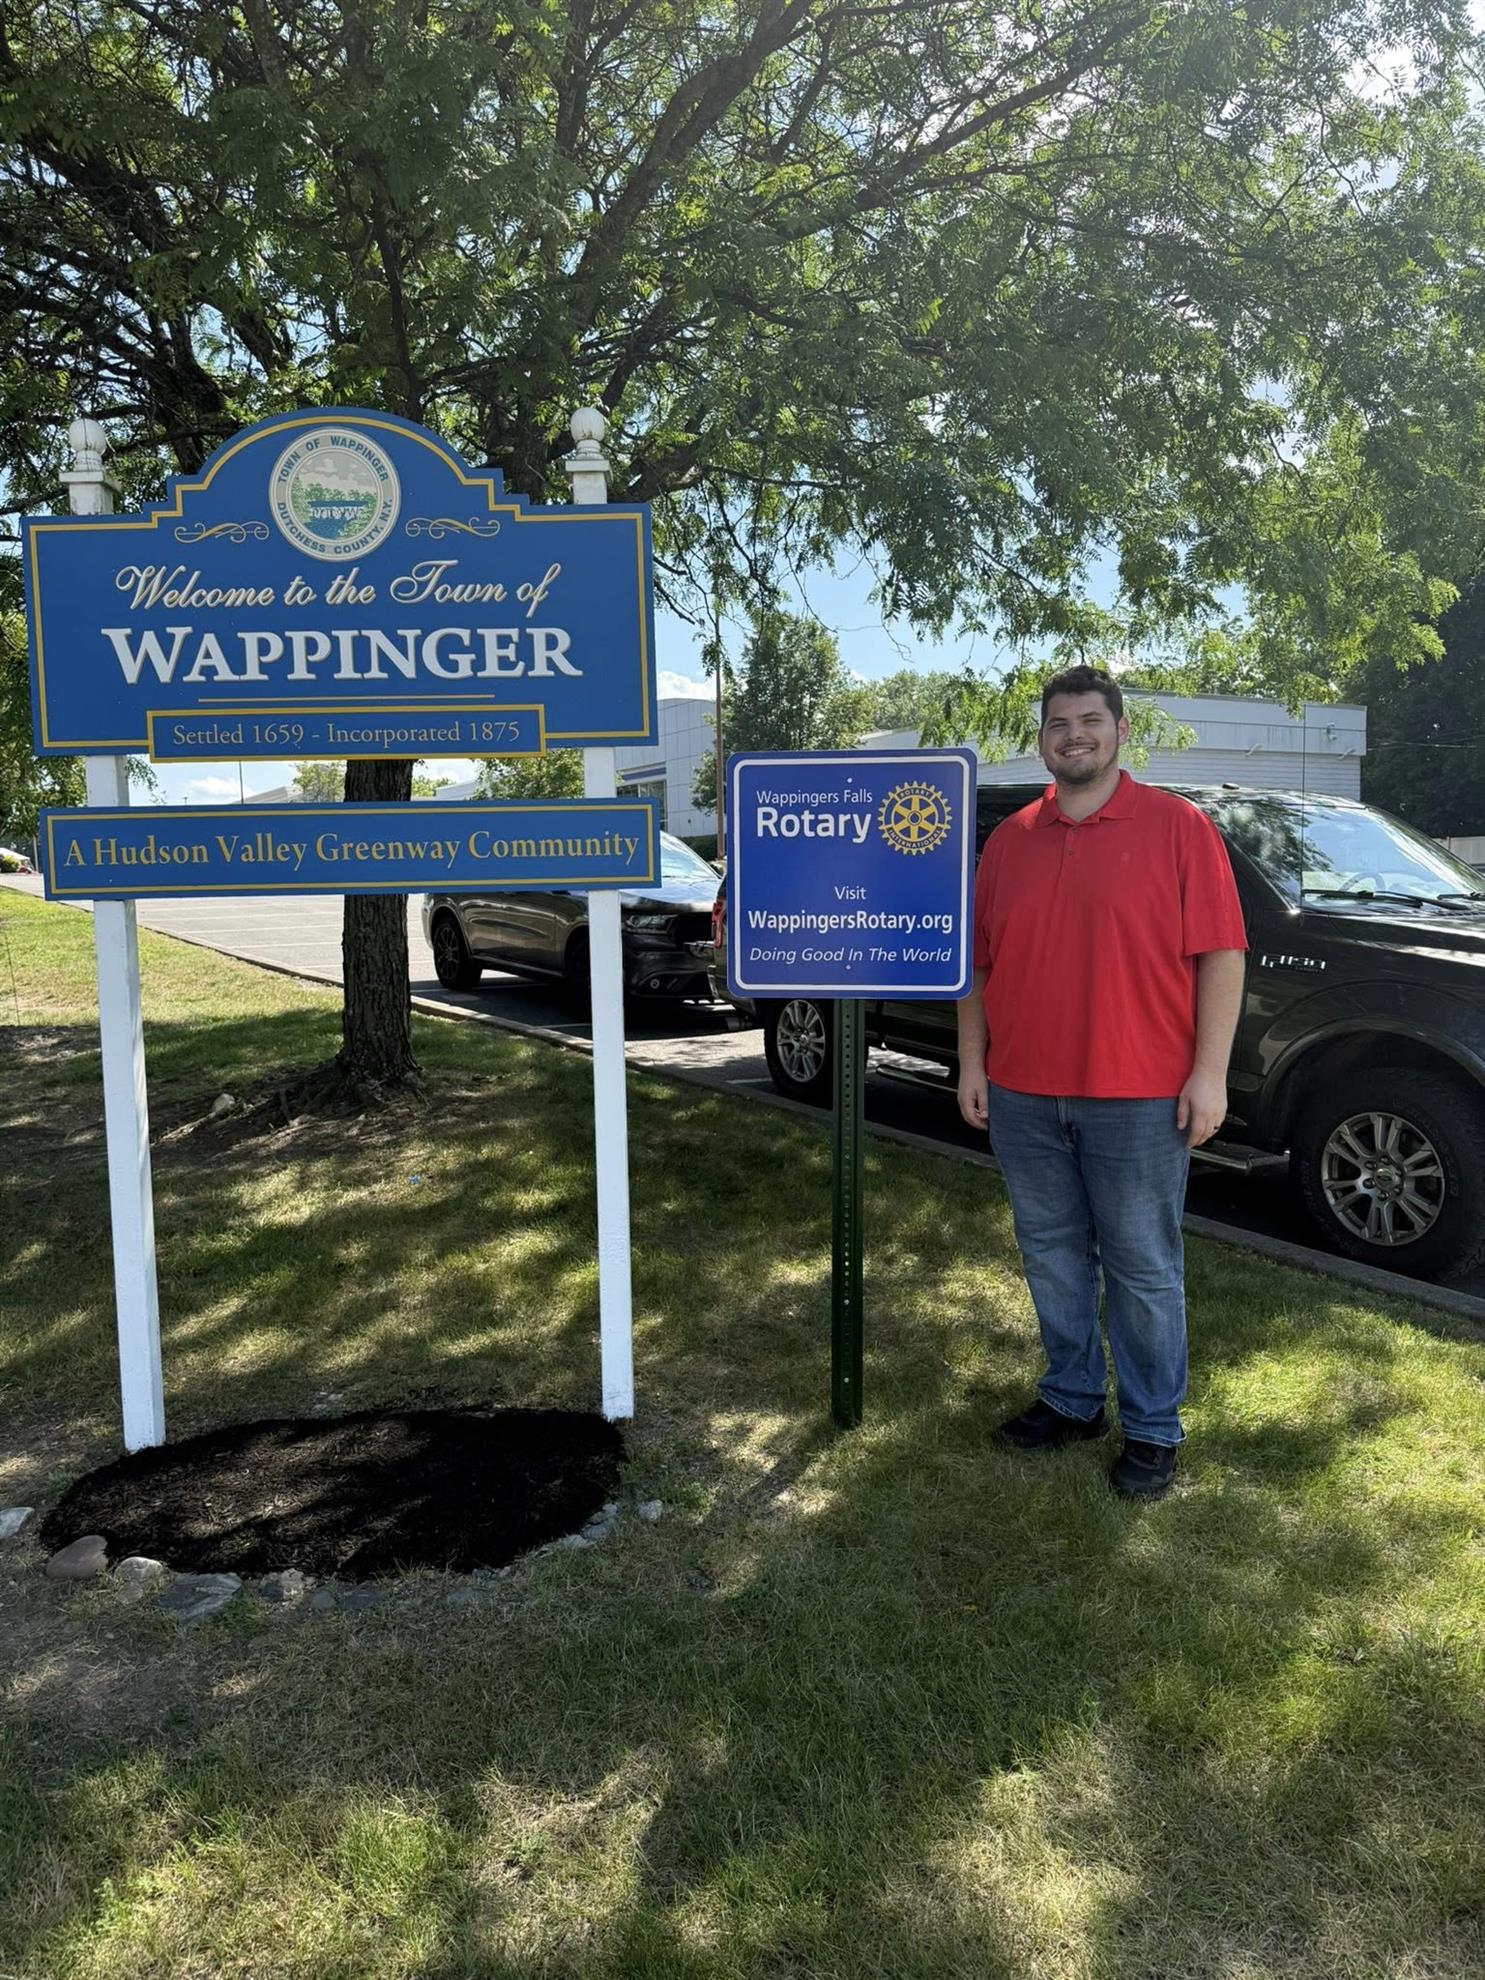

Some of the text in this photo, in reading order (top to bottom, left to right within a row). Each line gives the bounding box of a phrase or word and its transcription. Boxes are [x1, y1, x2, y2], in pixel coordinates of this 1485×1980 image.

[278, 435, 389, 484] TOWN OF WAPPINGER
[277, 502, 326, 553] DUTCHESS
[115, 559, 562, 619] Welcome to the Town of
[101, 626, 584, 685] WAPPINGER
[173, 723, 244, 745] Settled
[253, 723, 304, 747] 1659
[327, 721, 461, 749] Incorporated
[471, 721, 519, 742] 1875
[756, 789, 873, 807] Wappingers Falls
[757, 807, 872, 843] Rotary
[889, 830, 941, 848] INTERNATIONAL
[64, 830, 640, 872] A Hudson Valley Greenway Community
[834, 886, 866, 900] Visit
[748, 909, 953, 933] WappingersRotary.org
[750, 947, 951, 964] Doing Good In The World
